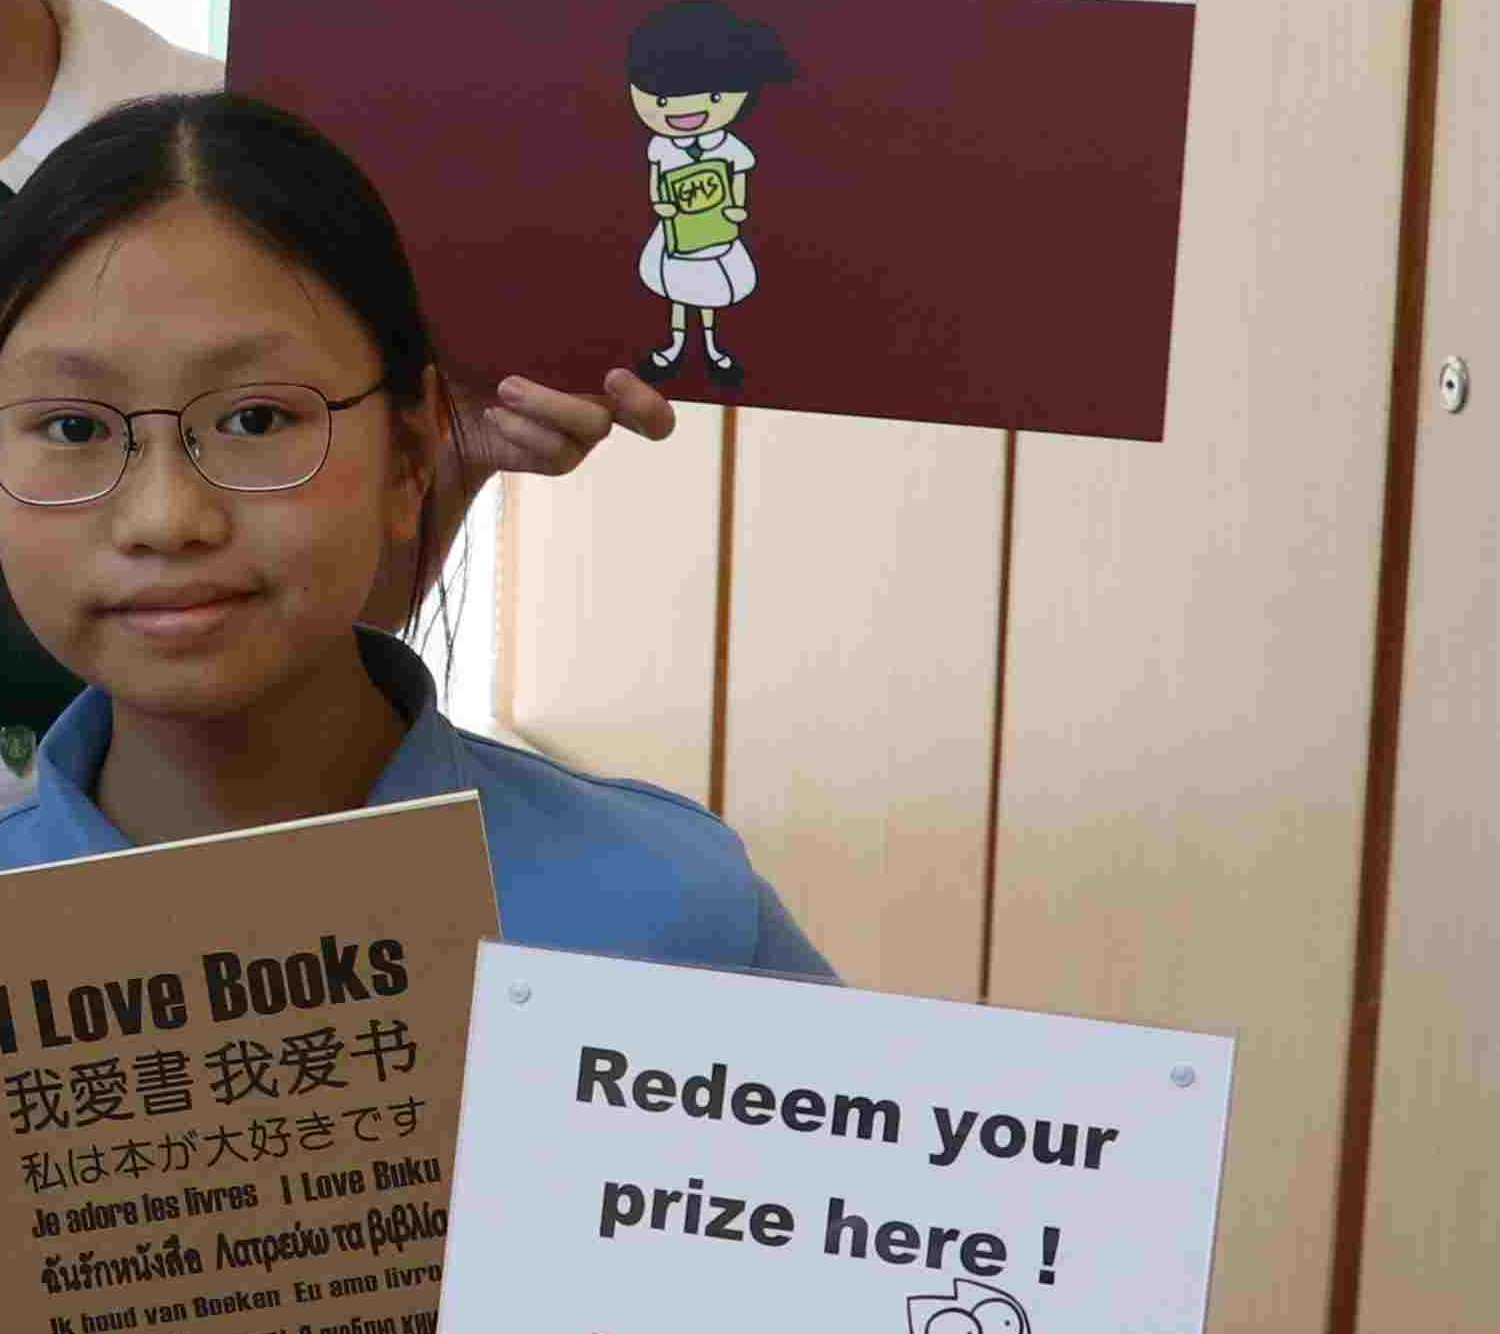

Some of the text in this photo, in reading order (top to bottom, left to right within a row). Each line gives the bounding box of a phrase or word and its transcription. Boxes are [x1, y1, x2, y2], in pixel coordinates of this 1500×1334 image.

[676, 174, 720, 209] GHS
[30, 973, 188, 1048] Love
[202, 937, 408, 1022] Books
[4, 1019, 417, 1134] 我愛書 我爱书
[575, 1046, 1120, 1170] Redeem your
[21, 1096, 425, 1193] 私は本が大好きです
[31, 1156, 441, 1238] Je adore les livres I Love Buku
[599, 1177, 1061, 1286] prize here !
